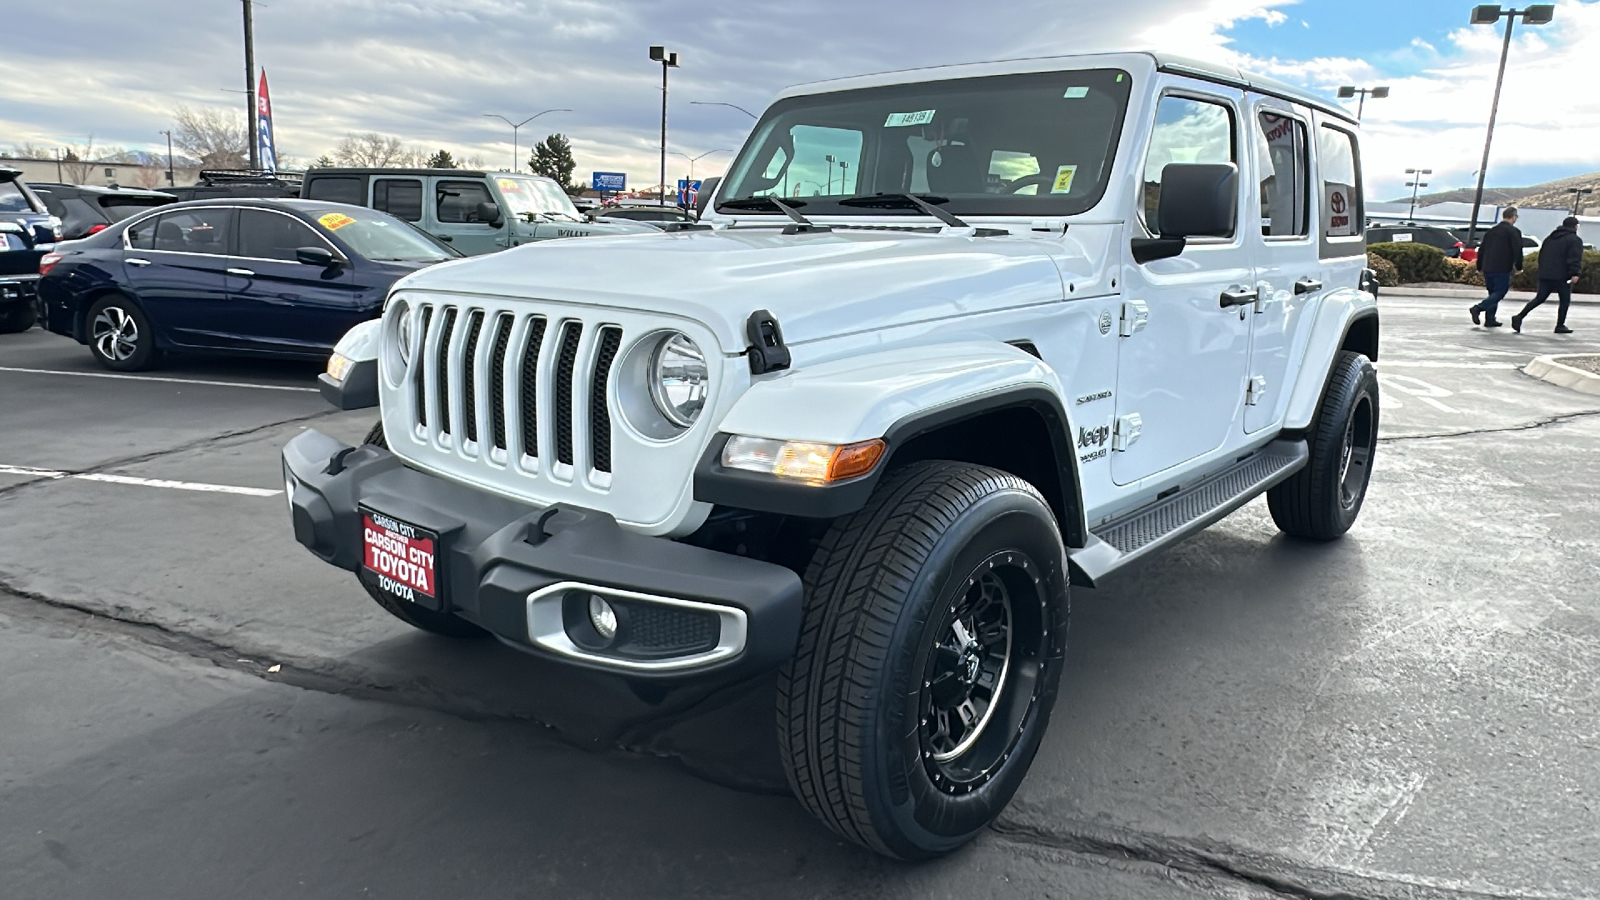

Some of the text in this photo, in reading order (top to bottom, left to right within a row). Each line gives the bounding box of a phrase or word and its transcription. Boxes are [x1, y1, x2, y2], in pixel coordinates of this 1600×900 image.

[1076, 390, 1112, 406] SAHARA
[1077, 425, 1110, 449] Jeep
[373, 513, 416, 539] CARSON CITY
[385, 529, 409, 545] ANOTHER
[364, 527, 434, 570] CARSON CITY
[371, 546, 429, 591] TOYOTA
[378, 574, 415, 603] TOYOTA
